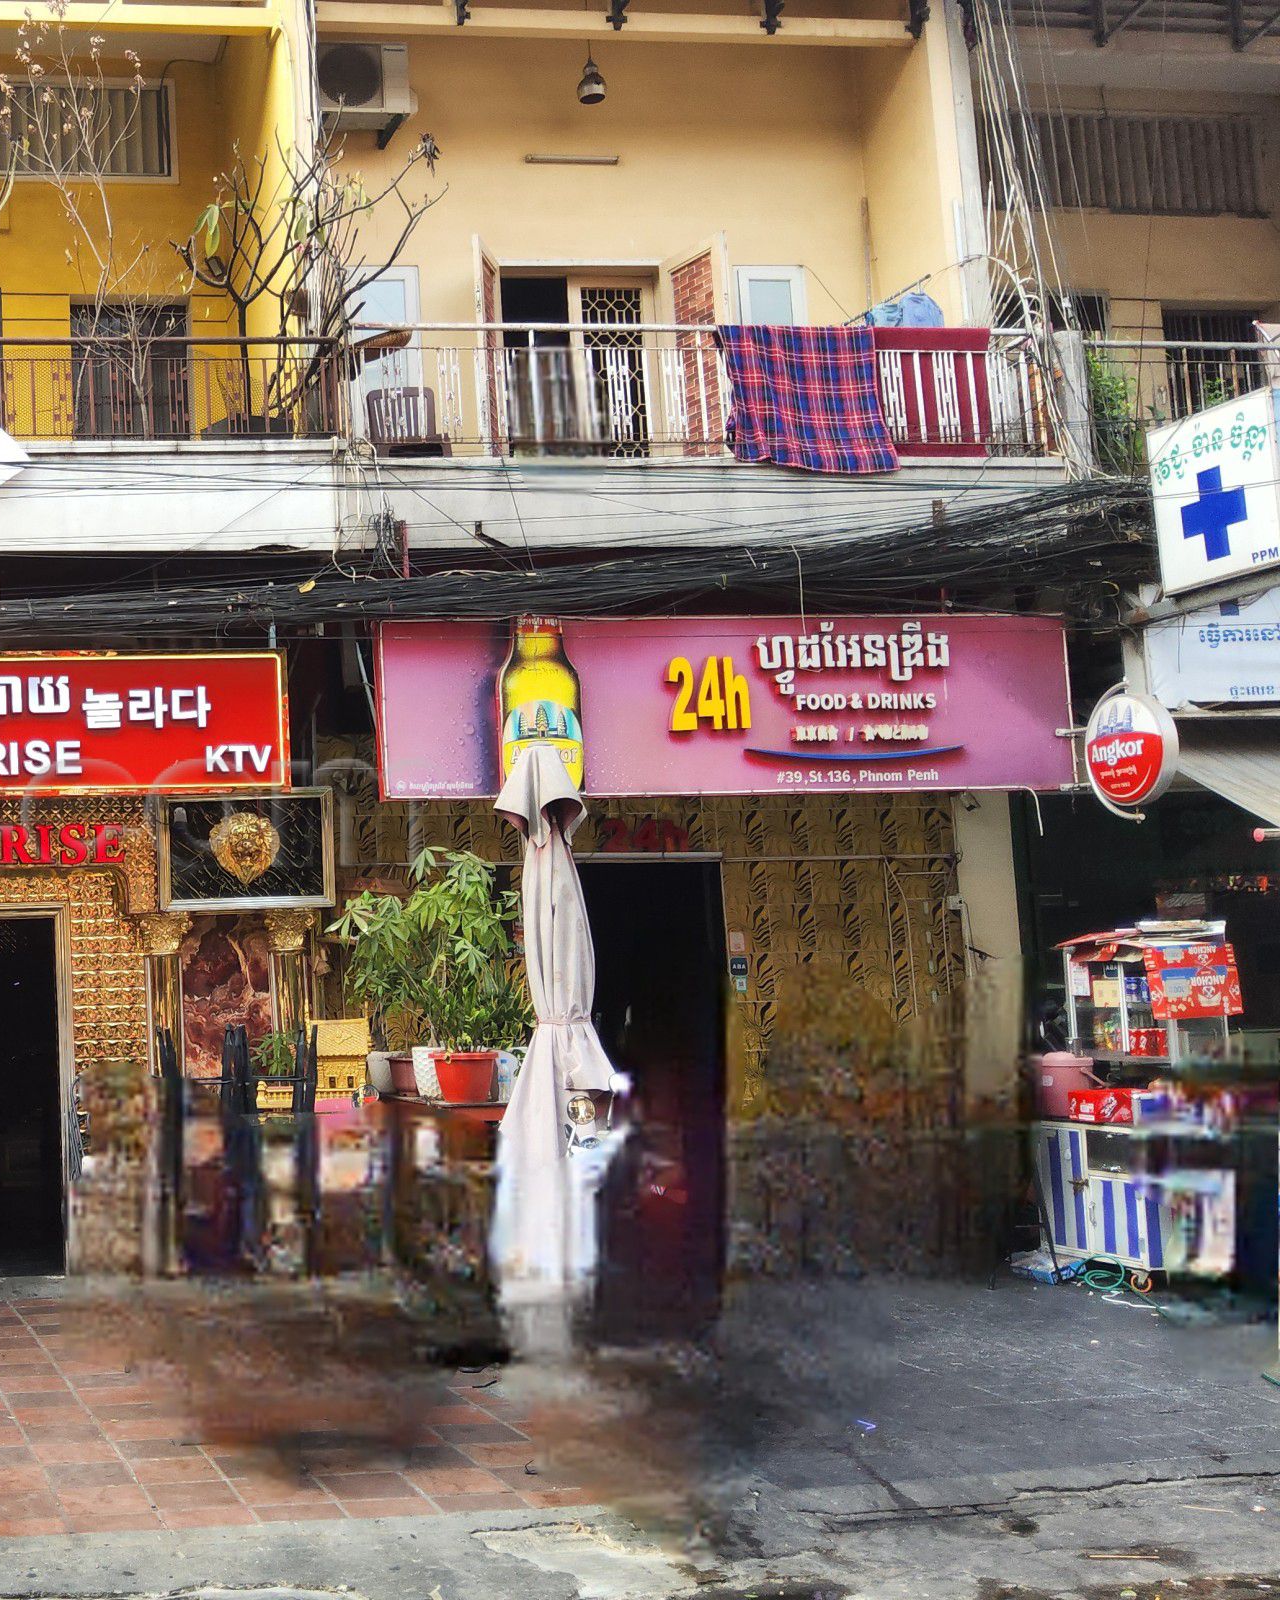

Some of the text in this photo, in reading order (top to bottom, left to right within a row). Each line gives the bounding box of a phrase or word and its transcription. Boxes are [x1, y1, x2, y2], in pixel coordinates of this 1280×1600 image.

[82, 685, 212, 730] 놀라다
[667, 656, 752, 731] 24h
[795, 691, 937, 711] FOOD & DRINKS
[206, 745, 272, 773] KTV
[1092, 738, 1145, 766] Angkor
[859, 768, 903, 782] Phnom
[907, 767, 939, 781] Penh
[1190, 975, 1226, 987] ANCHOR
